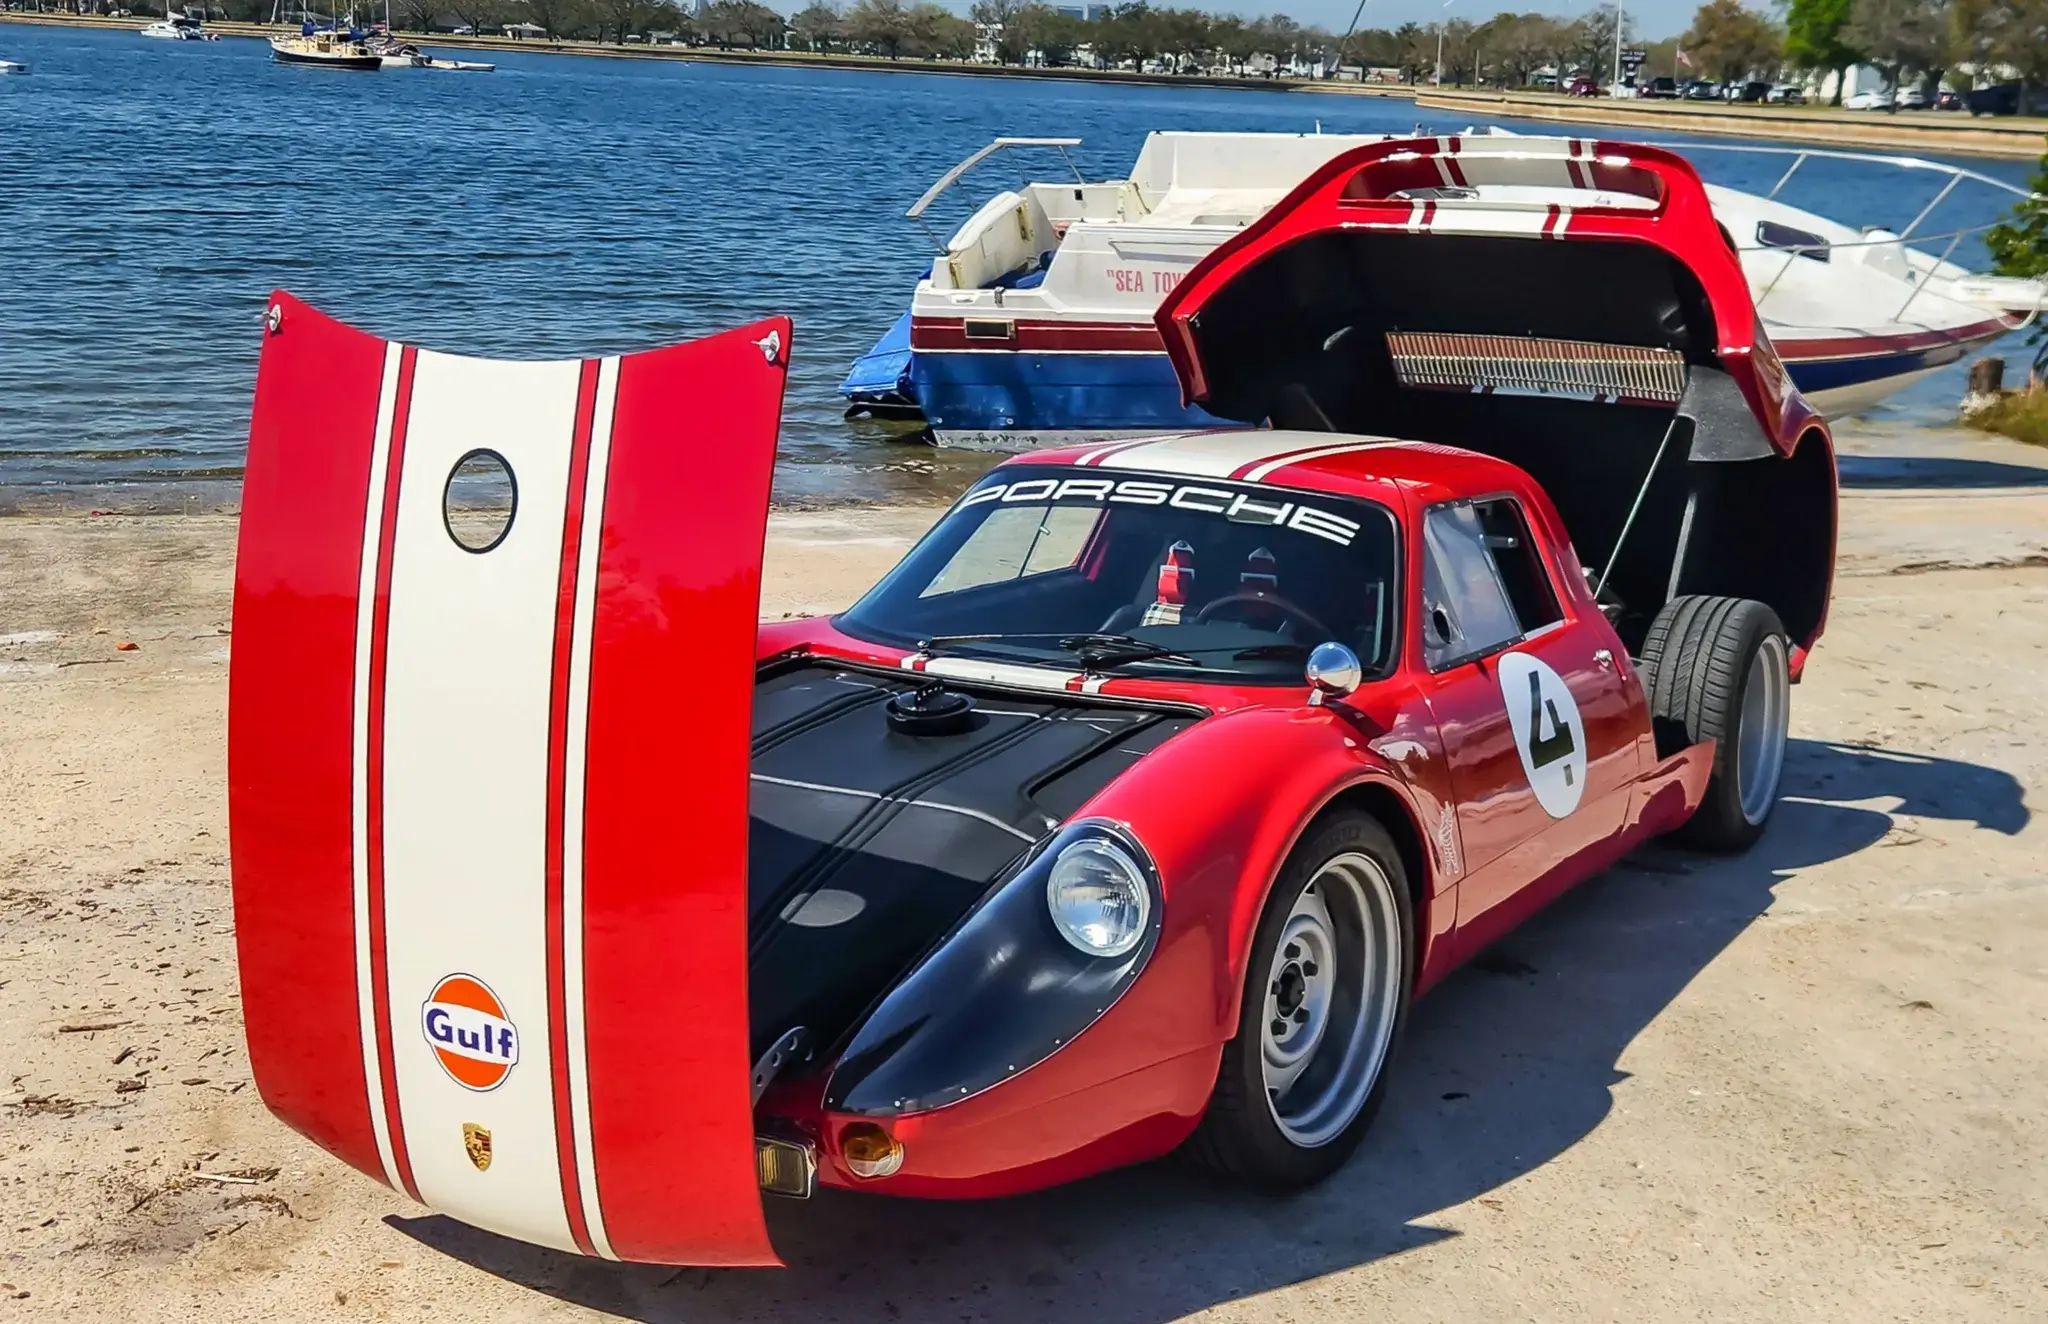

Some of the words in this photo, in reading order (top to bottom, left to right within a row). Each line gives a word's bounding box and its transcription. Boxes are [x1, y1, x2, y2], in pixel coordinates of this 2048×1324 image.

[1152, 271, 1187, 293] TOY
[955, 479, 1360, 546] PORSCHE
[1528, 670, 1575, 787] 4
[426, 1008, 513, 1058] Gulf
